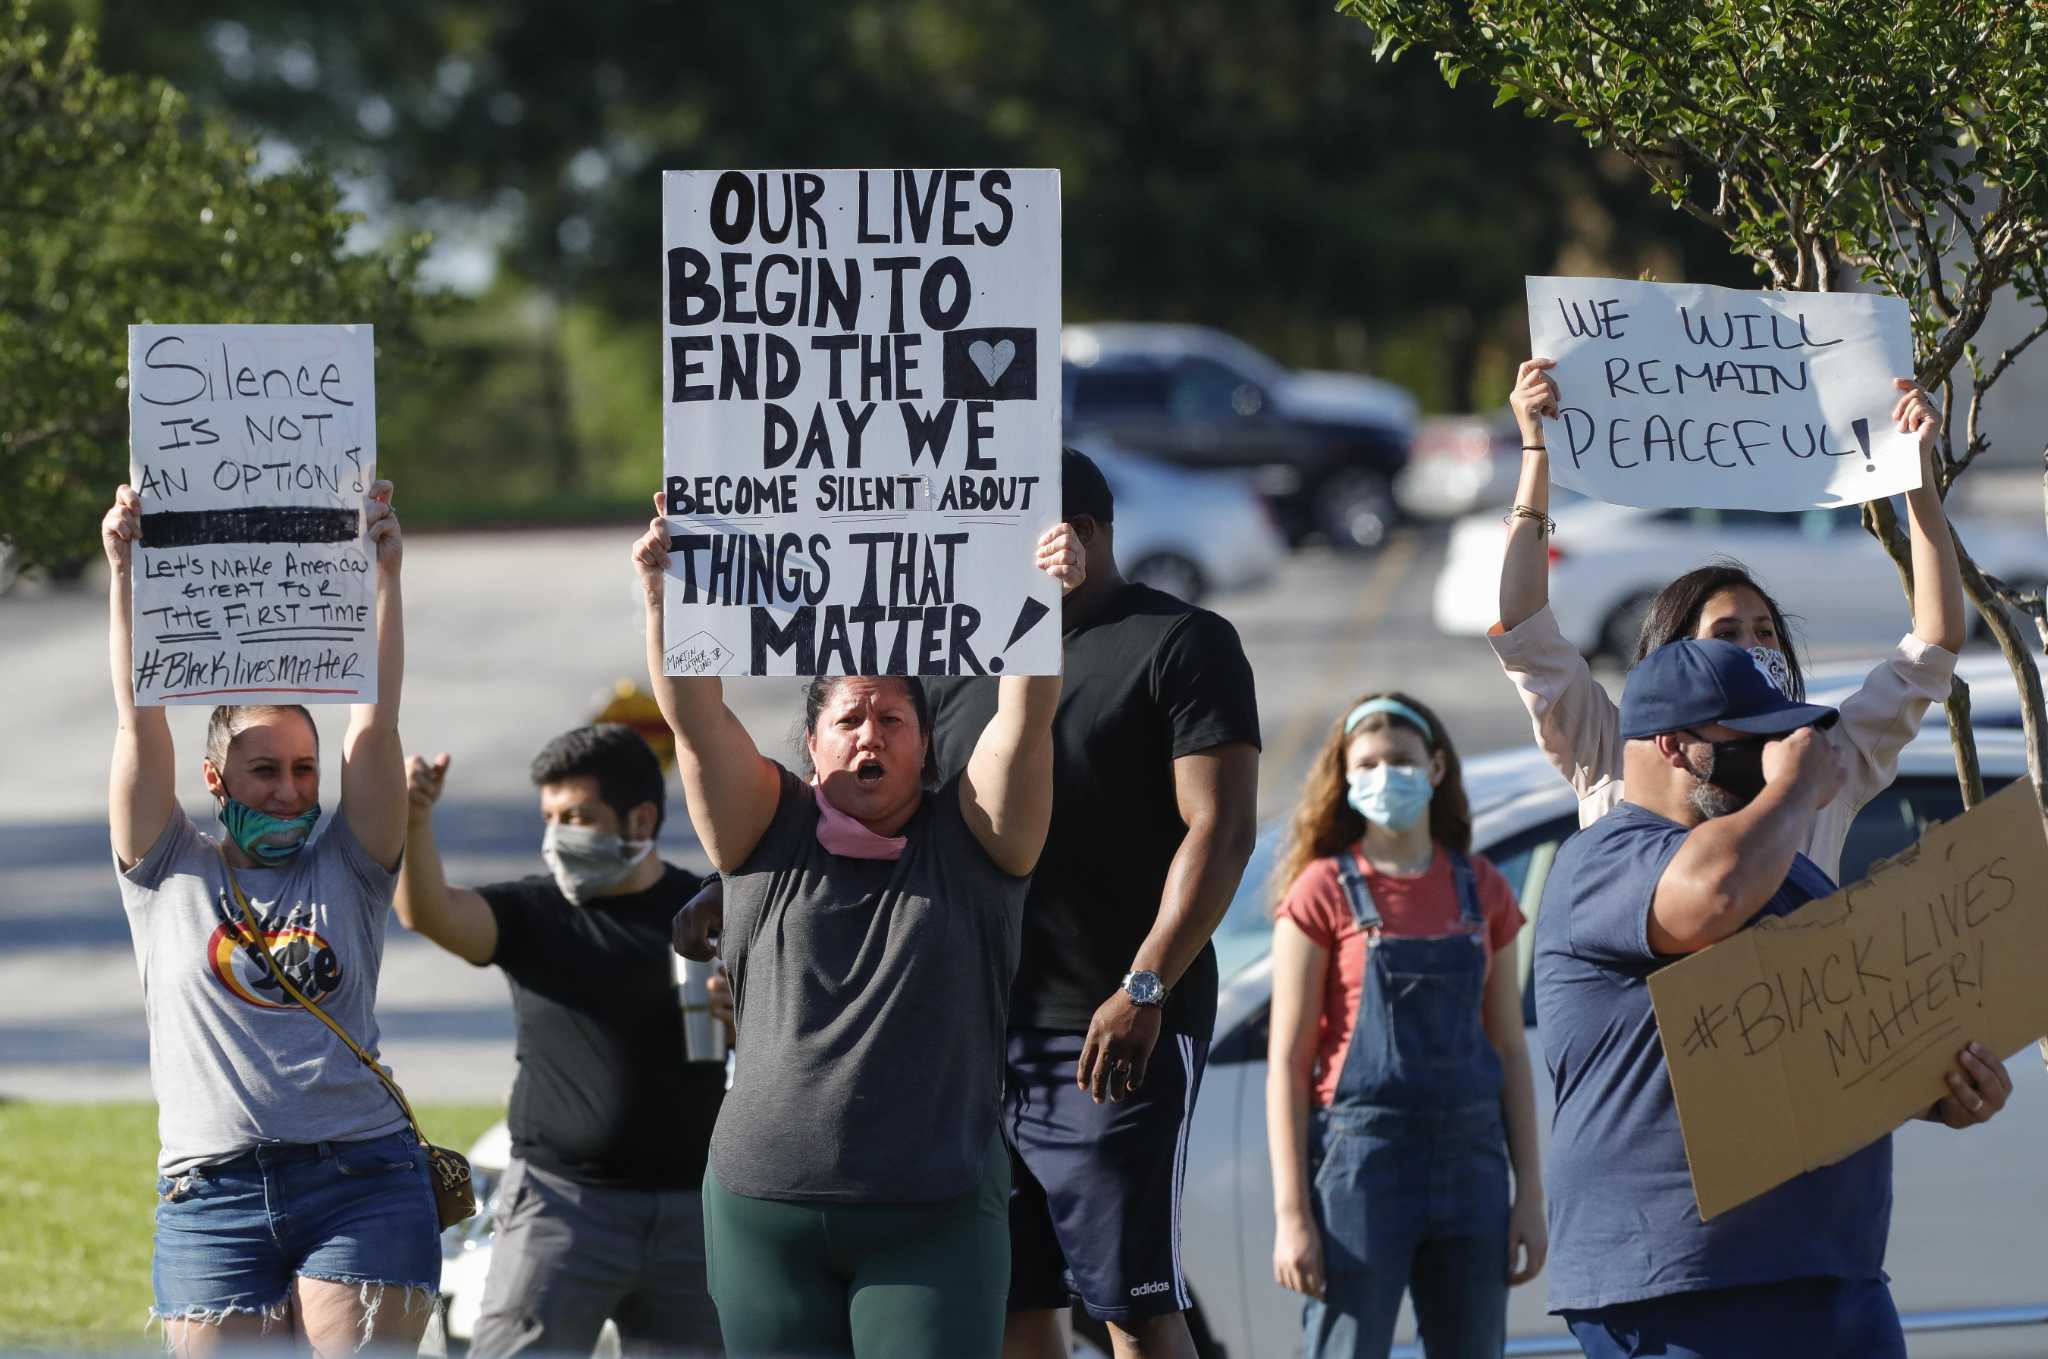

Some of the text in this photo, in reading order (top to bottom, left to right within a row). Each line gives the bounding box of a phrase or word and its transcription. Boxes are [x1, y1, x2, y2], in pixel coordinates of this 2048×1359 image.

[709, 169, 1014, 250] OUR LIVES
[667, 247, 972, 333] BEGIN TO
[1557, 297, 1844, 350] WE WILL
[139, 335, 354, 407] Silence
[671, 332, 924, 403] END THE
[1604, 357, 1807, 398] REMAIN
[158, 413, 334, 451] IS NOT
[763, 400, 998, 471] DAY WE
[1560, 407, 1876, 473] PEACEFUL!
[138, 463, 190, 501] AN
[665, 474, 1040, 516] BECOME SILENT ABOUT
[145, 553, 204, 580] Let's
[277, 580, 342, 598] FOR
[667, 532, 970, 607] THINGS THAT
[141, 605, 212, 629] THE
[308, 602, 369, 623] TIME
[750, 596, 1051, 677] MATTER!
[1901, 856, 2016, 968] LIVES
[1823, 940, 1986, 1078] MATTER!
[1130, 1281, 1170, 1296] adidas
